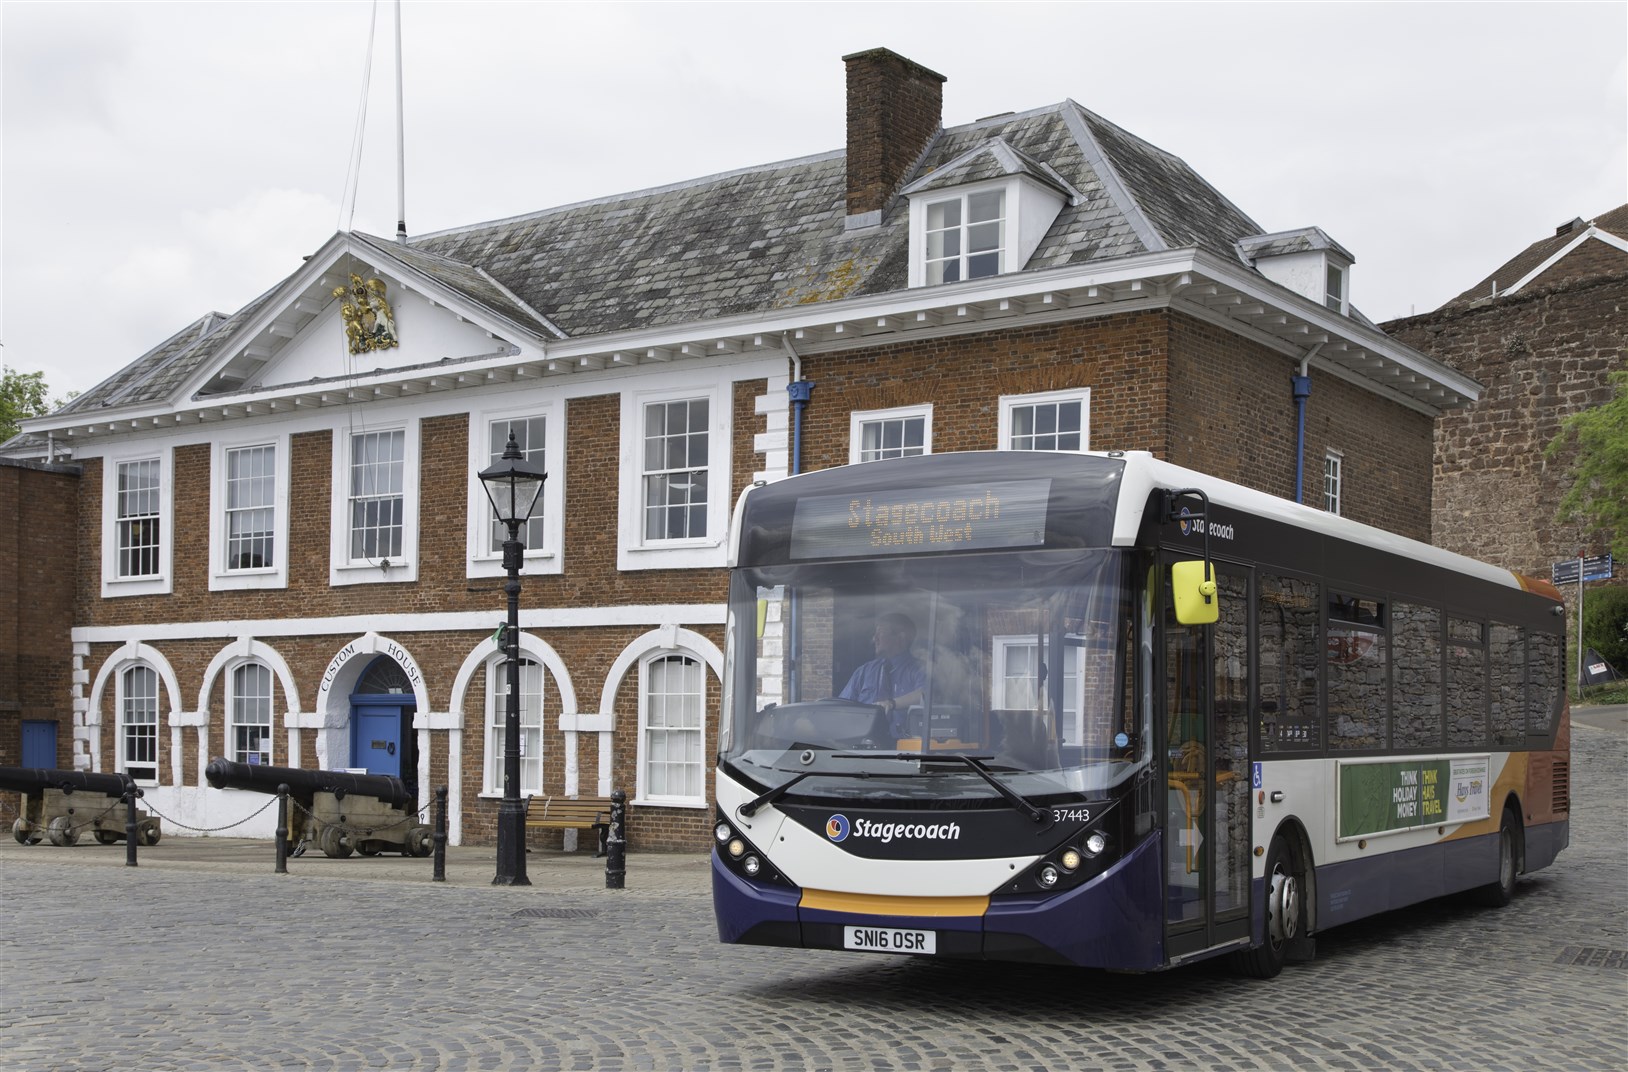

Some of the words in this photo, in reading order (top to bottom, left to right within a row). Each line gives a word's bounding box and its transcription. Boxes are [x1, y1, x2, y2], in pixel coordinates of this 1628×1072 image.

[848, 490, 1000, 528] Stagecoach
[871, 526, 924, 547] South
[929, 522, 973, 543] West
[1192, 518, 1234, 541] Staecoach
[321, 644, 355, 692] CUSTOM
[387, 643, 421, 688] HOUSE
[1400, 770, 1417, 785] THINK
[1422, 769, 1437, 784] THINK
[1393, 786, 1417, 802] HOLIDAY
[1422, 785, 1435, 800] HAYS
[1053, 809, 1090, 822] 37443
[1397, 801, 1417, 818] MONEY
[853, 818, 961, 843] Stagecoach
[854, 929, 889, 949] SN16
[893, 931, 925, 950] OSR
